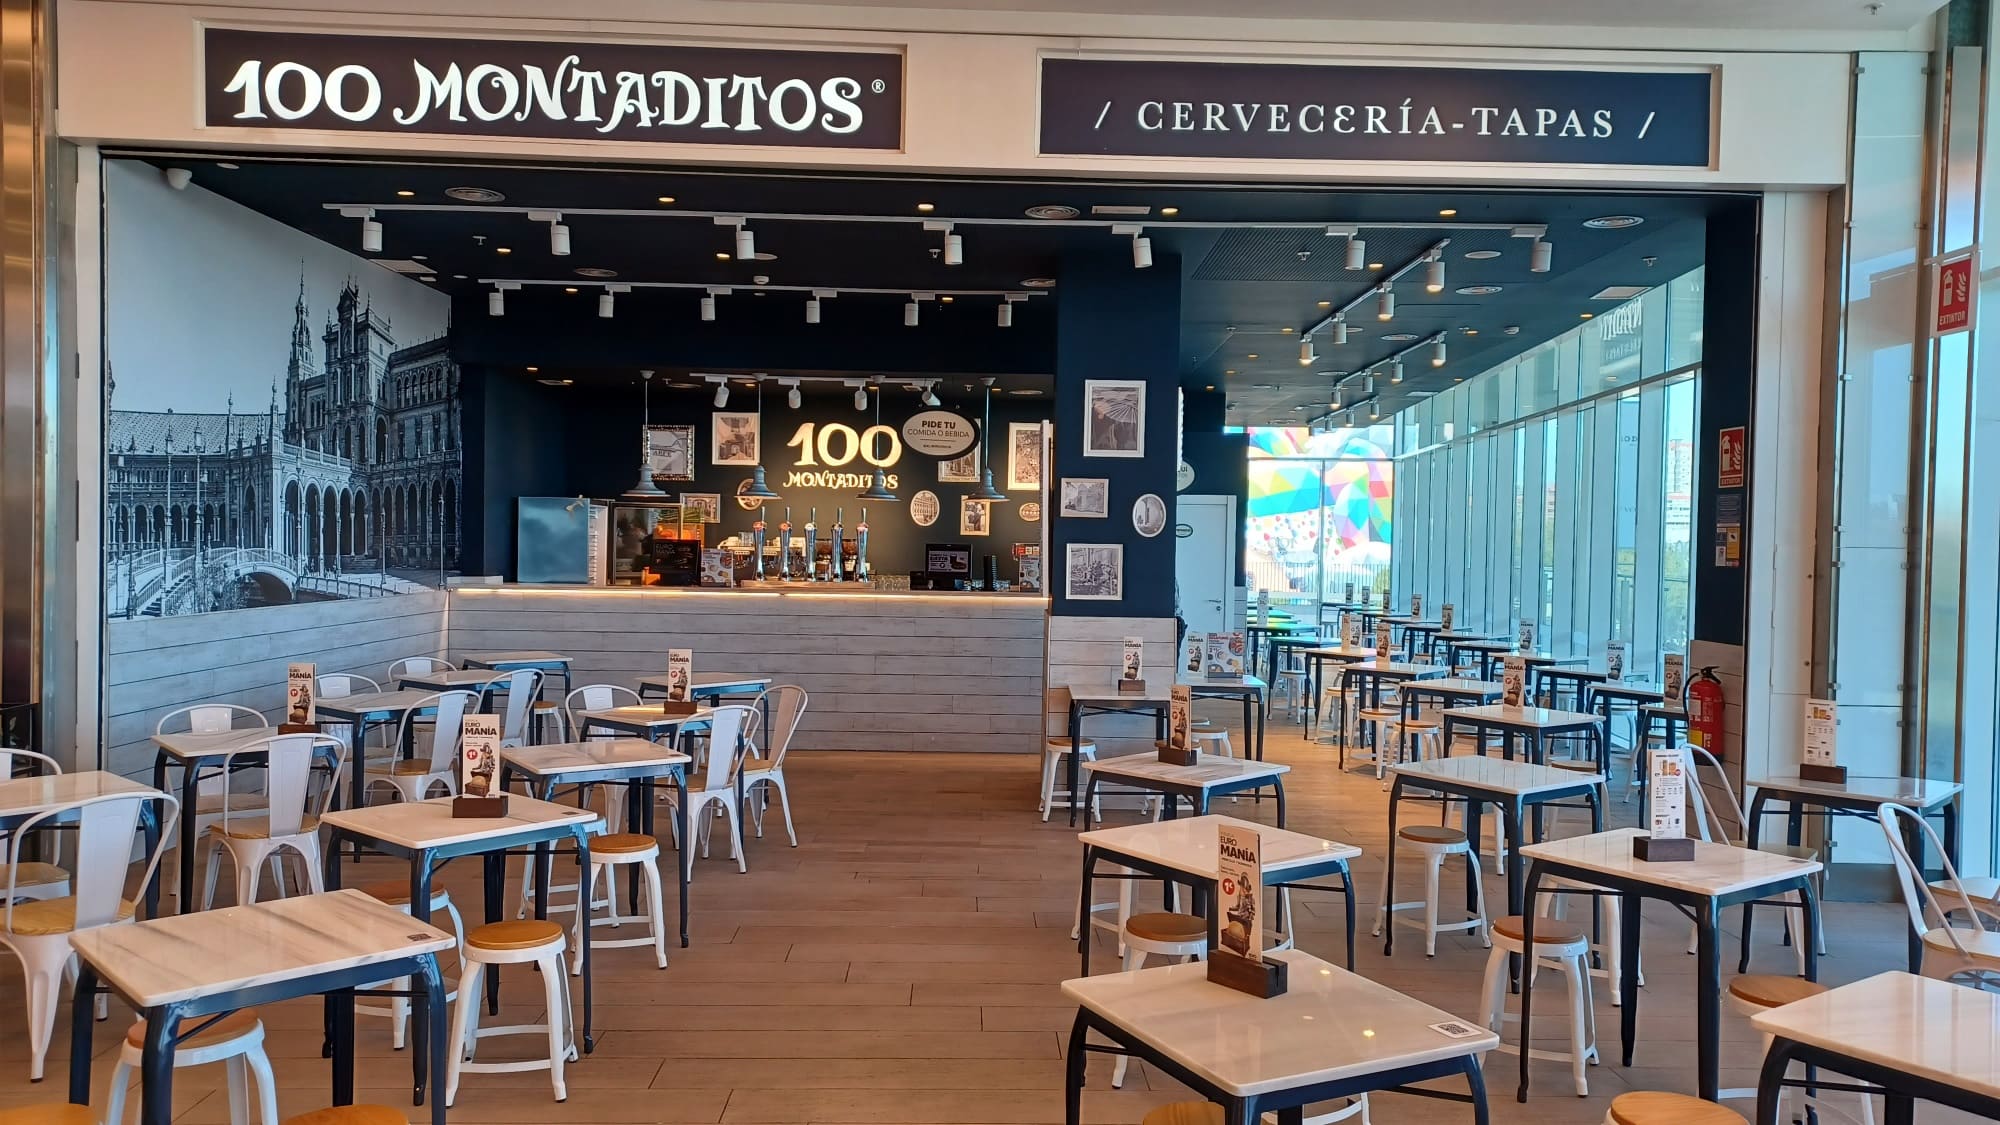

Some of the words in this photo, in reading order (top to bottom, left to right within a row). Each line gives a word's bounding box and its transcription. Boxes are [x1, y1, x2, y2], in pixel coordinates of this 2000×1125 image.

[225, 60, 382, 120] 100
[393, 55, 864, 132] MONTADITOS
[1940, 310, 1966, 326] EXTINTOR
[921, 420, 942, 429] PIDE
[944, 421, 956, 429] TU
[907, 428, 936, 437] COMIDA
[945, 430, 970, 438] BEBIDA
[787, 422, 902, 468] 100
[465, 726, 497, 736] MANÍA
[1220, 835, 1237, 846] EURO
[1220, 844, 1257, 864] MANÍA
